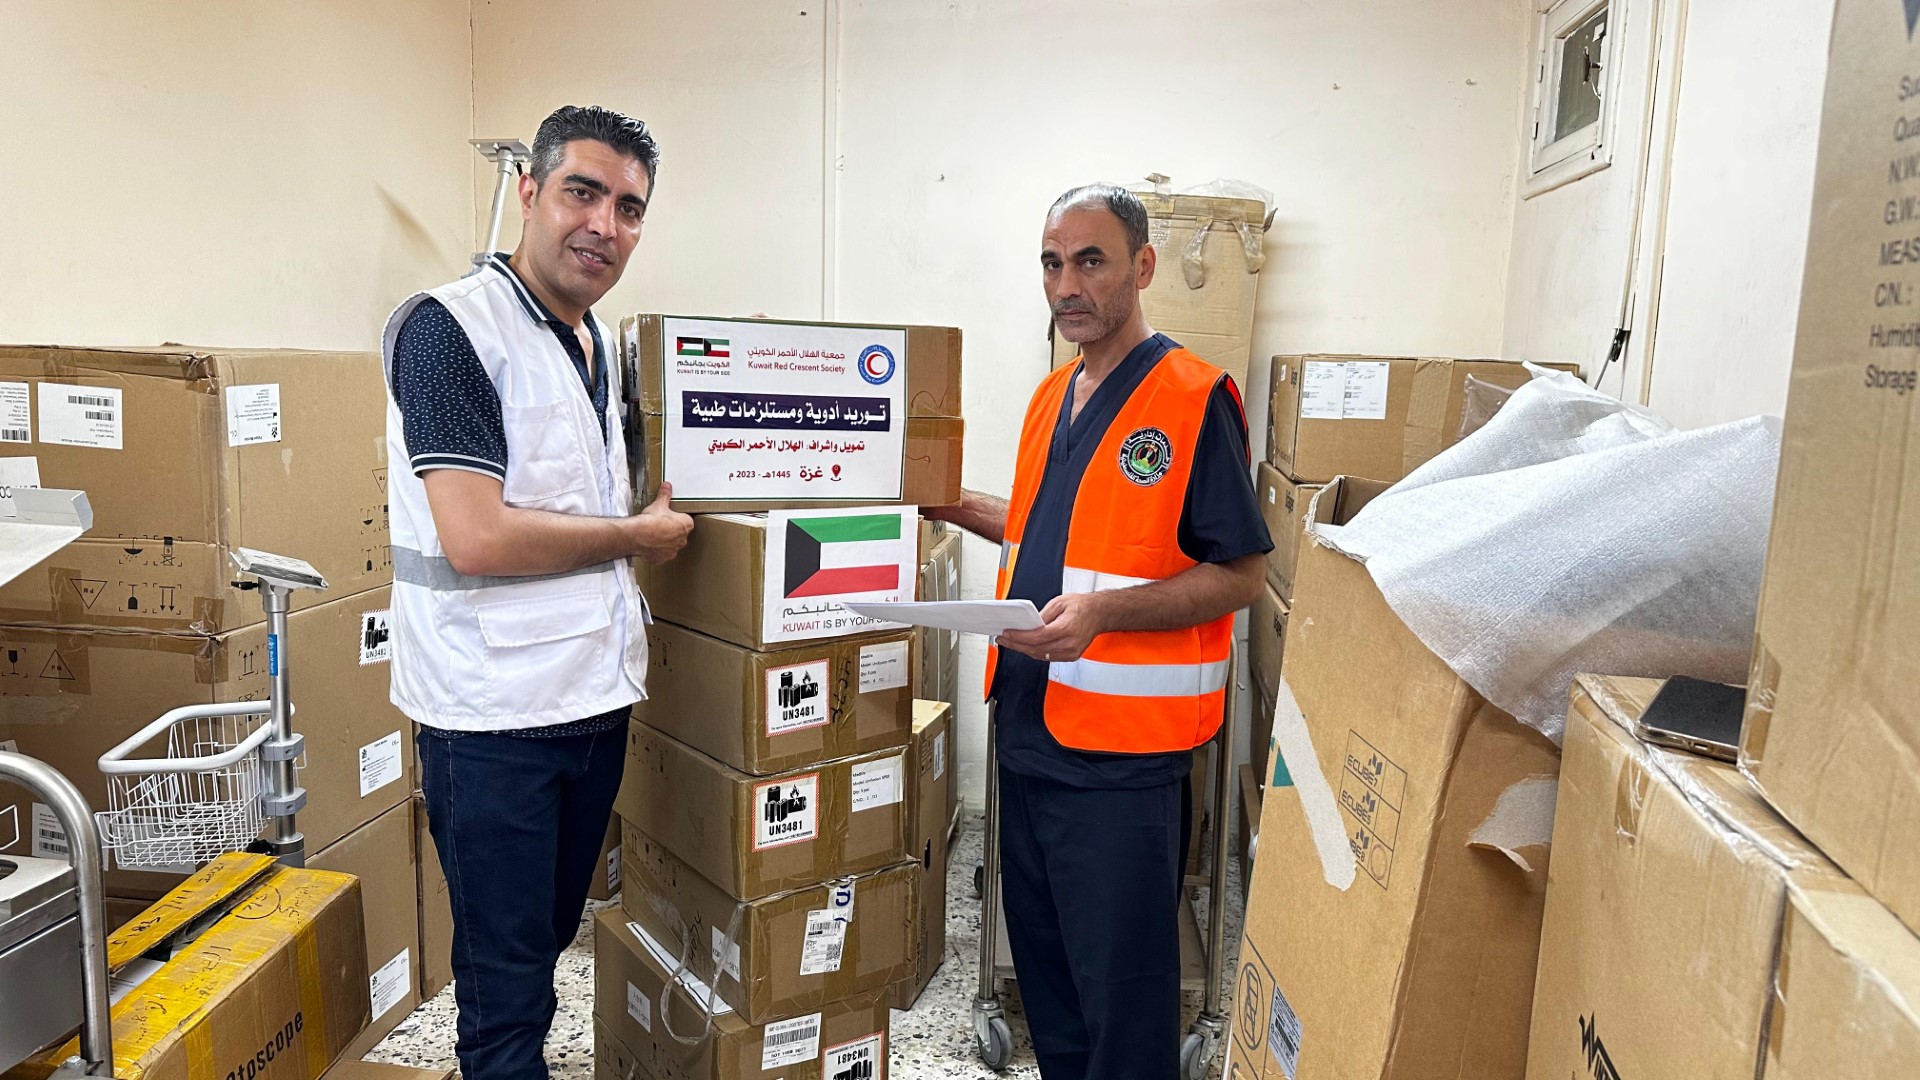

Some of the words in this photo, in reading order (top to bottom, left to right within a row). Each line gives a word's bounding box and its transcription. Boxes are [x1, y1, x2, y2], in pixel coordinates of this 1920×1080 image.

[747, 346, 776, 359] الكويتي
[777, 347, 798, 357] الأحمر
[799, 349, 820, 359] الهلال
[821, 351, 845, 361] جمعية
[748, 361, 773, 370] Kuwait
[774, 362, 788, 371] Red
[789, 362, 820, 372] Crescent
[821, 364, 845, 375] Society
[1864, 363, 1918, 396] Storage
[691, 399, 726, 423] طبية
[729, 400, 803, 423] ومستلزمات
[806, 400, 840, 425] أدوية
[844, 404, 886, 425] توريد
[708, 438, 745, 454] الكويتي
[748, 436, 776, 452] الأحمر
[778, 440, 804, 452] الهلال
[839, 440, 865, 453] تمويل
[728, 472, 734, 481] م
[736, 470, 756, 479] 2023
[799, 465, 824, 481] غزة
[782, 620, 820, 633] KUWAIT
[823, 619, 832, 629] IS
[835, 618, 847, 628] BY
[782, 705, 815, 721] UN3481
[1347, 754, 1378, 788] ECUBE7
[769, 820, 803, 836] UN3481
[837, 1047, 869, 1065] UN3481
